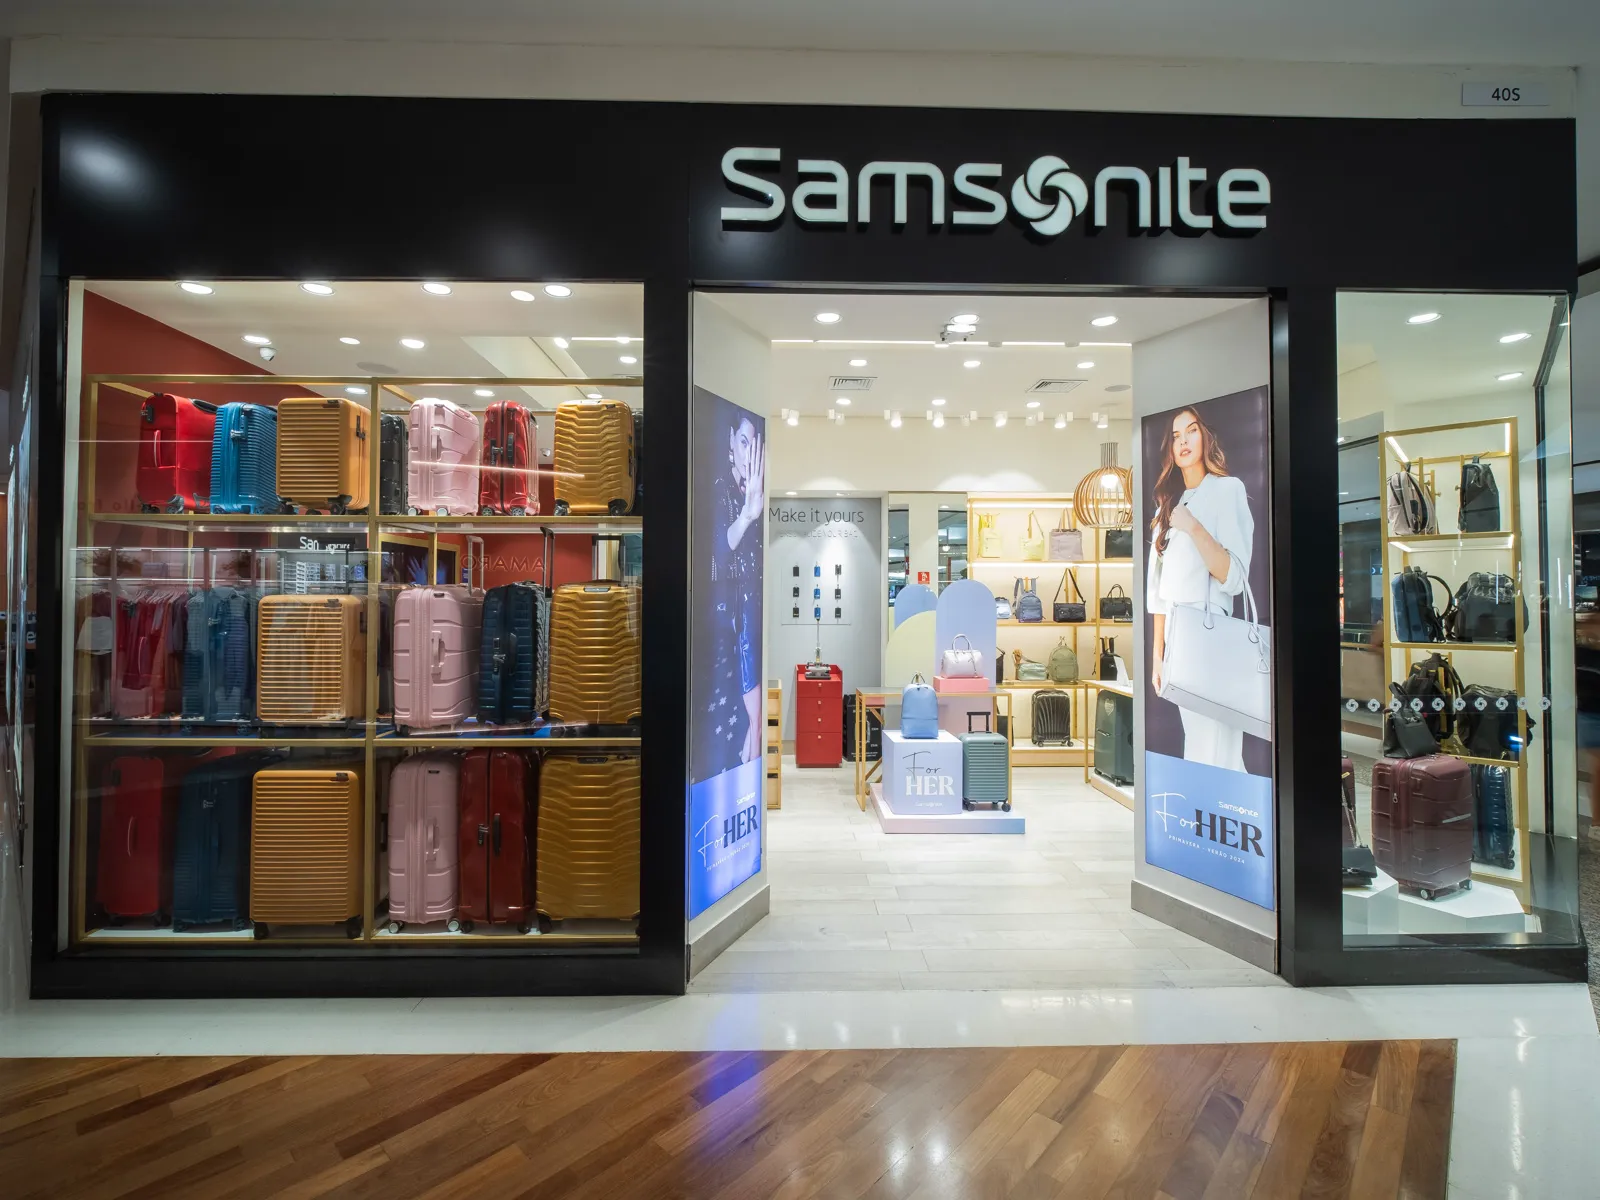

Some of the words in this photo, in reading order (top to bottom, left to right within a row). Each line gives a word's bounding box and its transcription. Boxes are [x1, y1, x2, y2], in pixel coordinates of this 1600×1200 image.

[1491, 87, 1521, 102] 40S
[721, 147, 1271, 236] Samsonite
[769, 507, 806, 522] Make
[810, 507, 820, 522] it
[824, 511, 864, 526] yours
[902, 750, 942, 781] For
[905, 775, 955, 796] HER
[1151, 792, 1199, 832] For
[1195, 809, 1265, 857] HER
[1218, 801, 1259, 818] Samsonite
[695, 814, 726, 868] For
[723, 804, 758, 849] HER
[1168, 834, 1200, 849] PRIMAVERA
[1229, 855, 1245, 864] 2024
